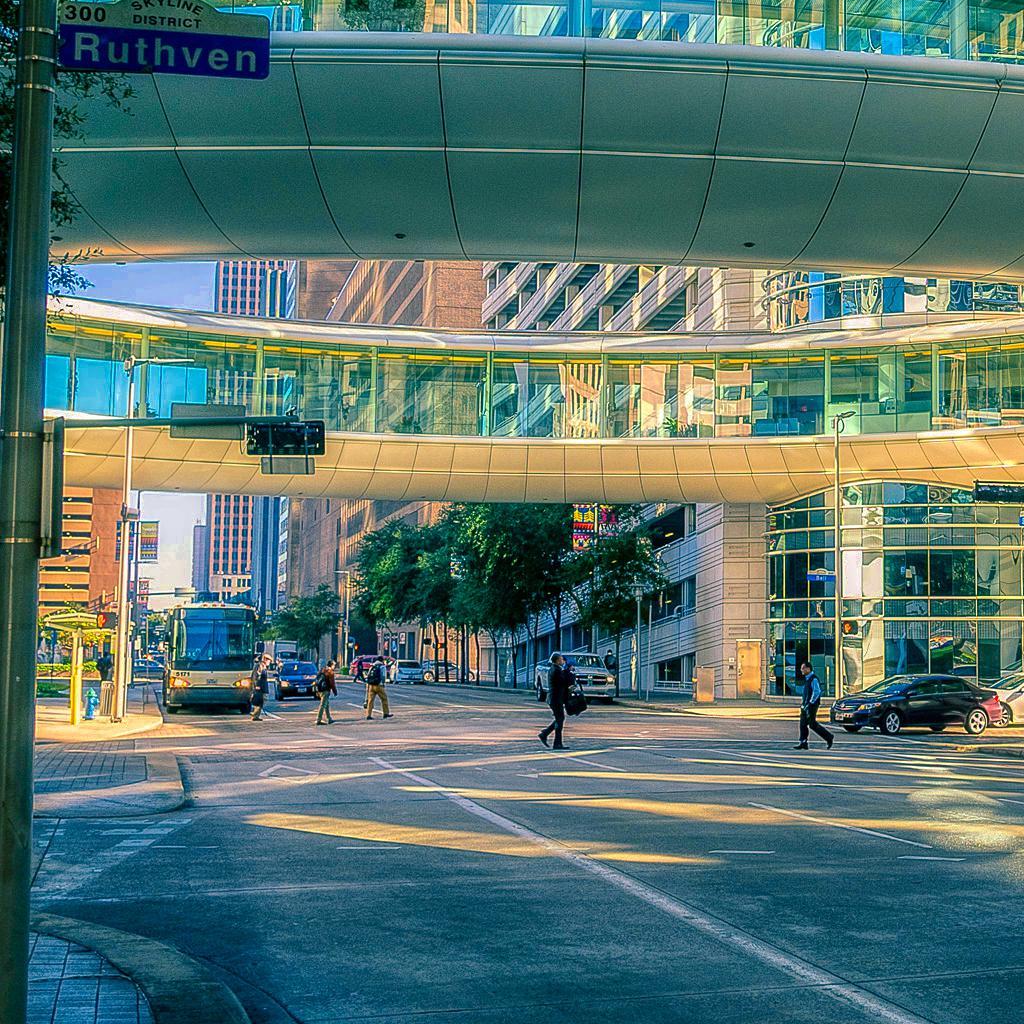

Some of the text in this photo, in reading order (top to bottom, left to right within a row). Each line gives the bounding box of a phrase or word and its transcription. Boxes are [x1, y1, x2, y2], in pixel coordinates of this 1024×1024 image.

[64, 4, 107, 23] 300
[132, 14, 203, 29] DISTRICT
[74, 32, 257, 73] Ruthven
